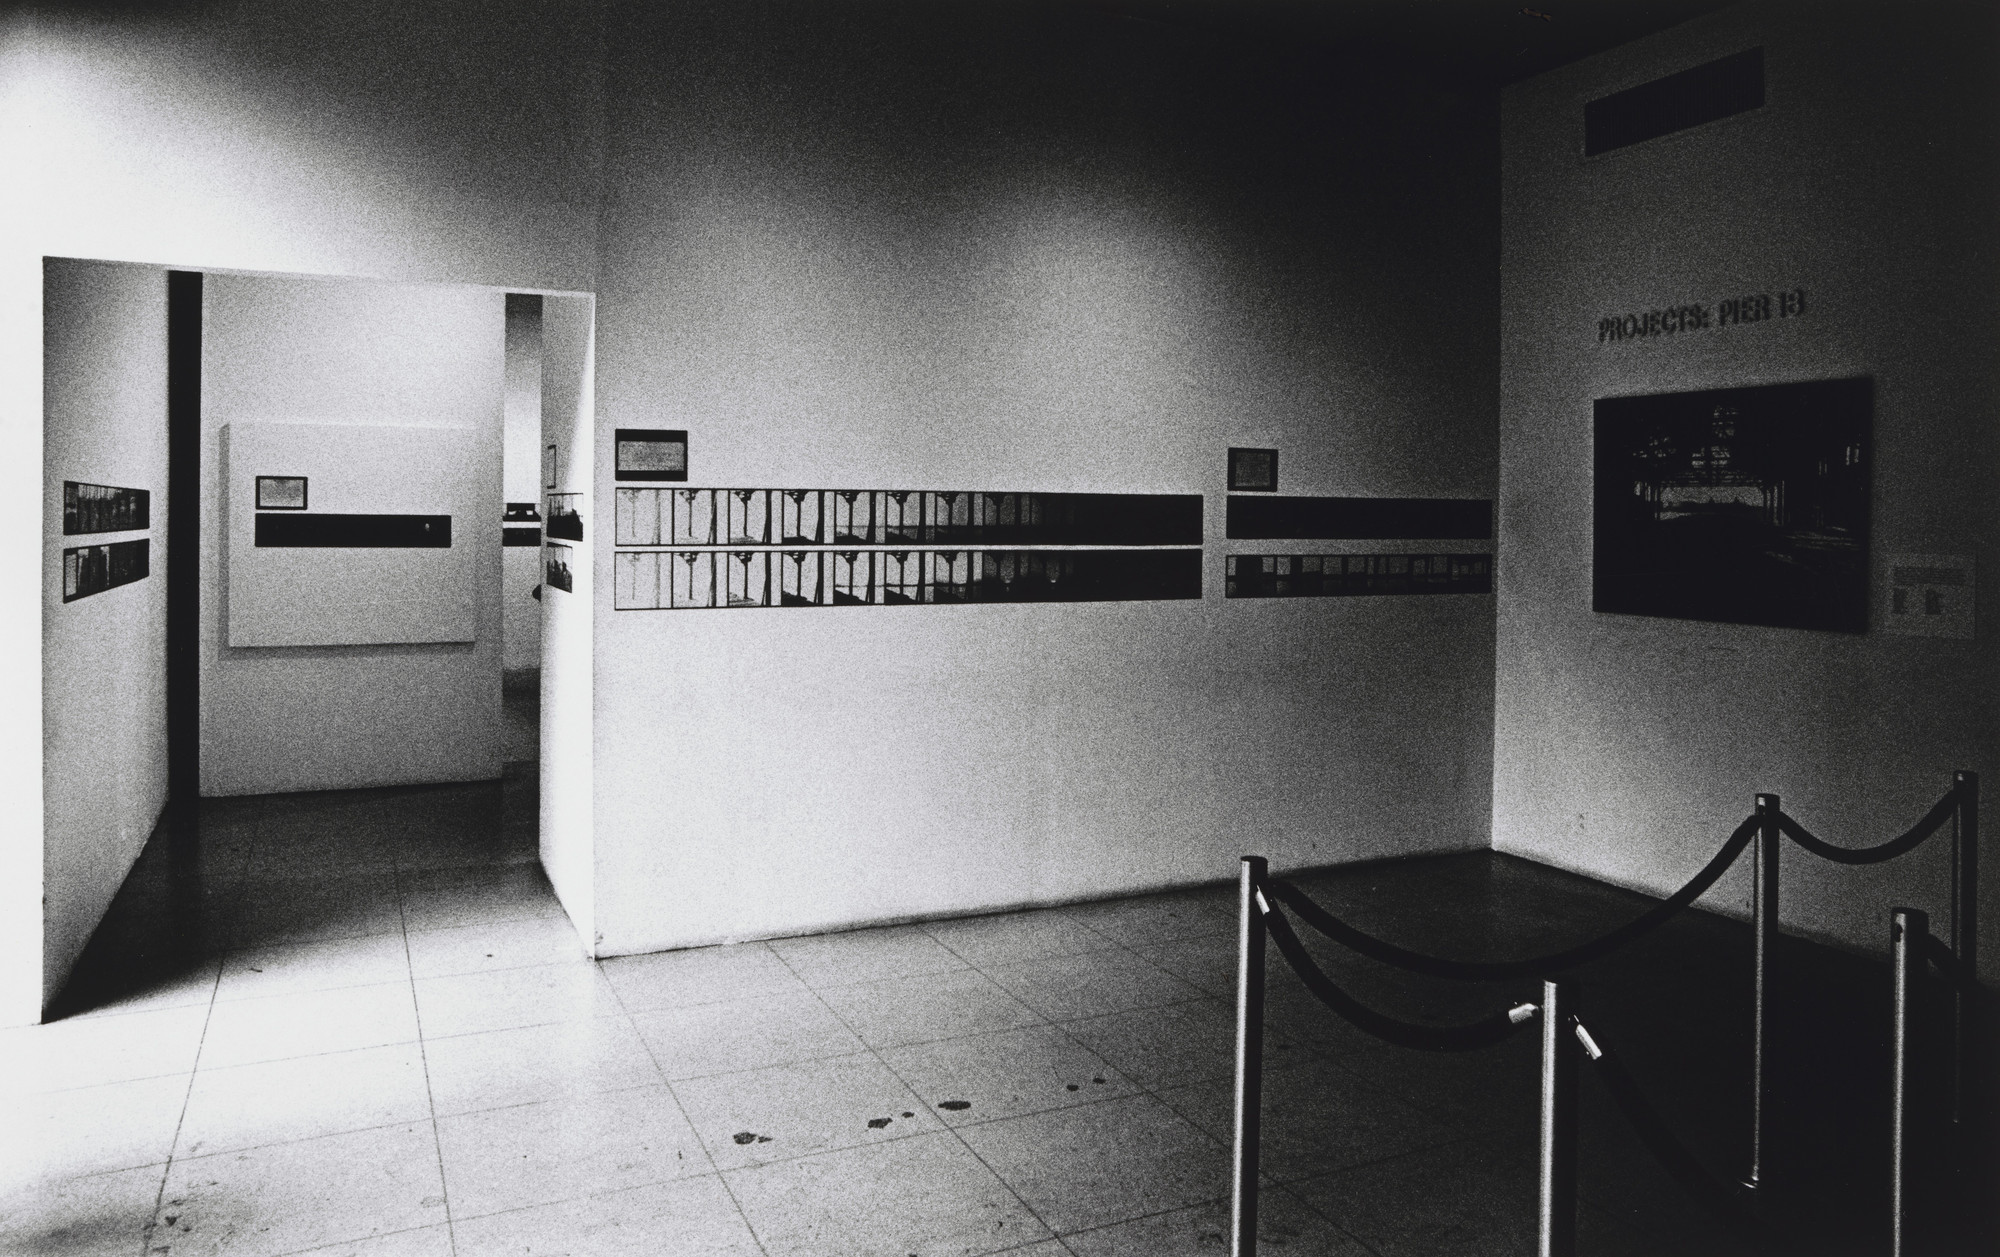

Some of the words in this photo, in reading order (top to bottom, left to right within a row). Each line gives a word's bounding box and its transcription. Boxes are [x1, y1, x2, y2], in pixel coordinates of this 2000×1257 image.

[1598, 302, 1709, 343] PROJECTS:
[1718, 293, 1771, 326] PIER
[1779, 287, 1805, 319] 13
